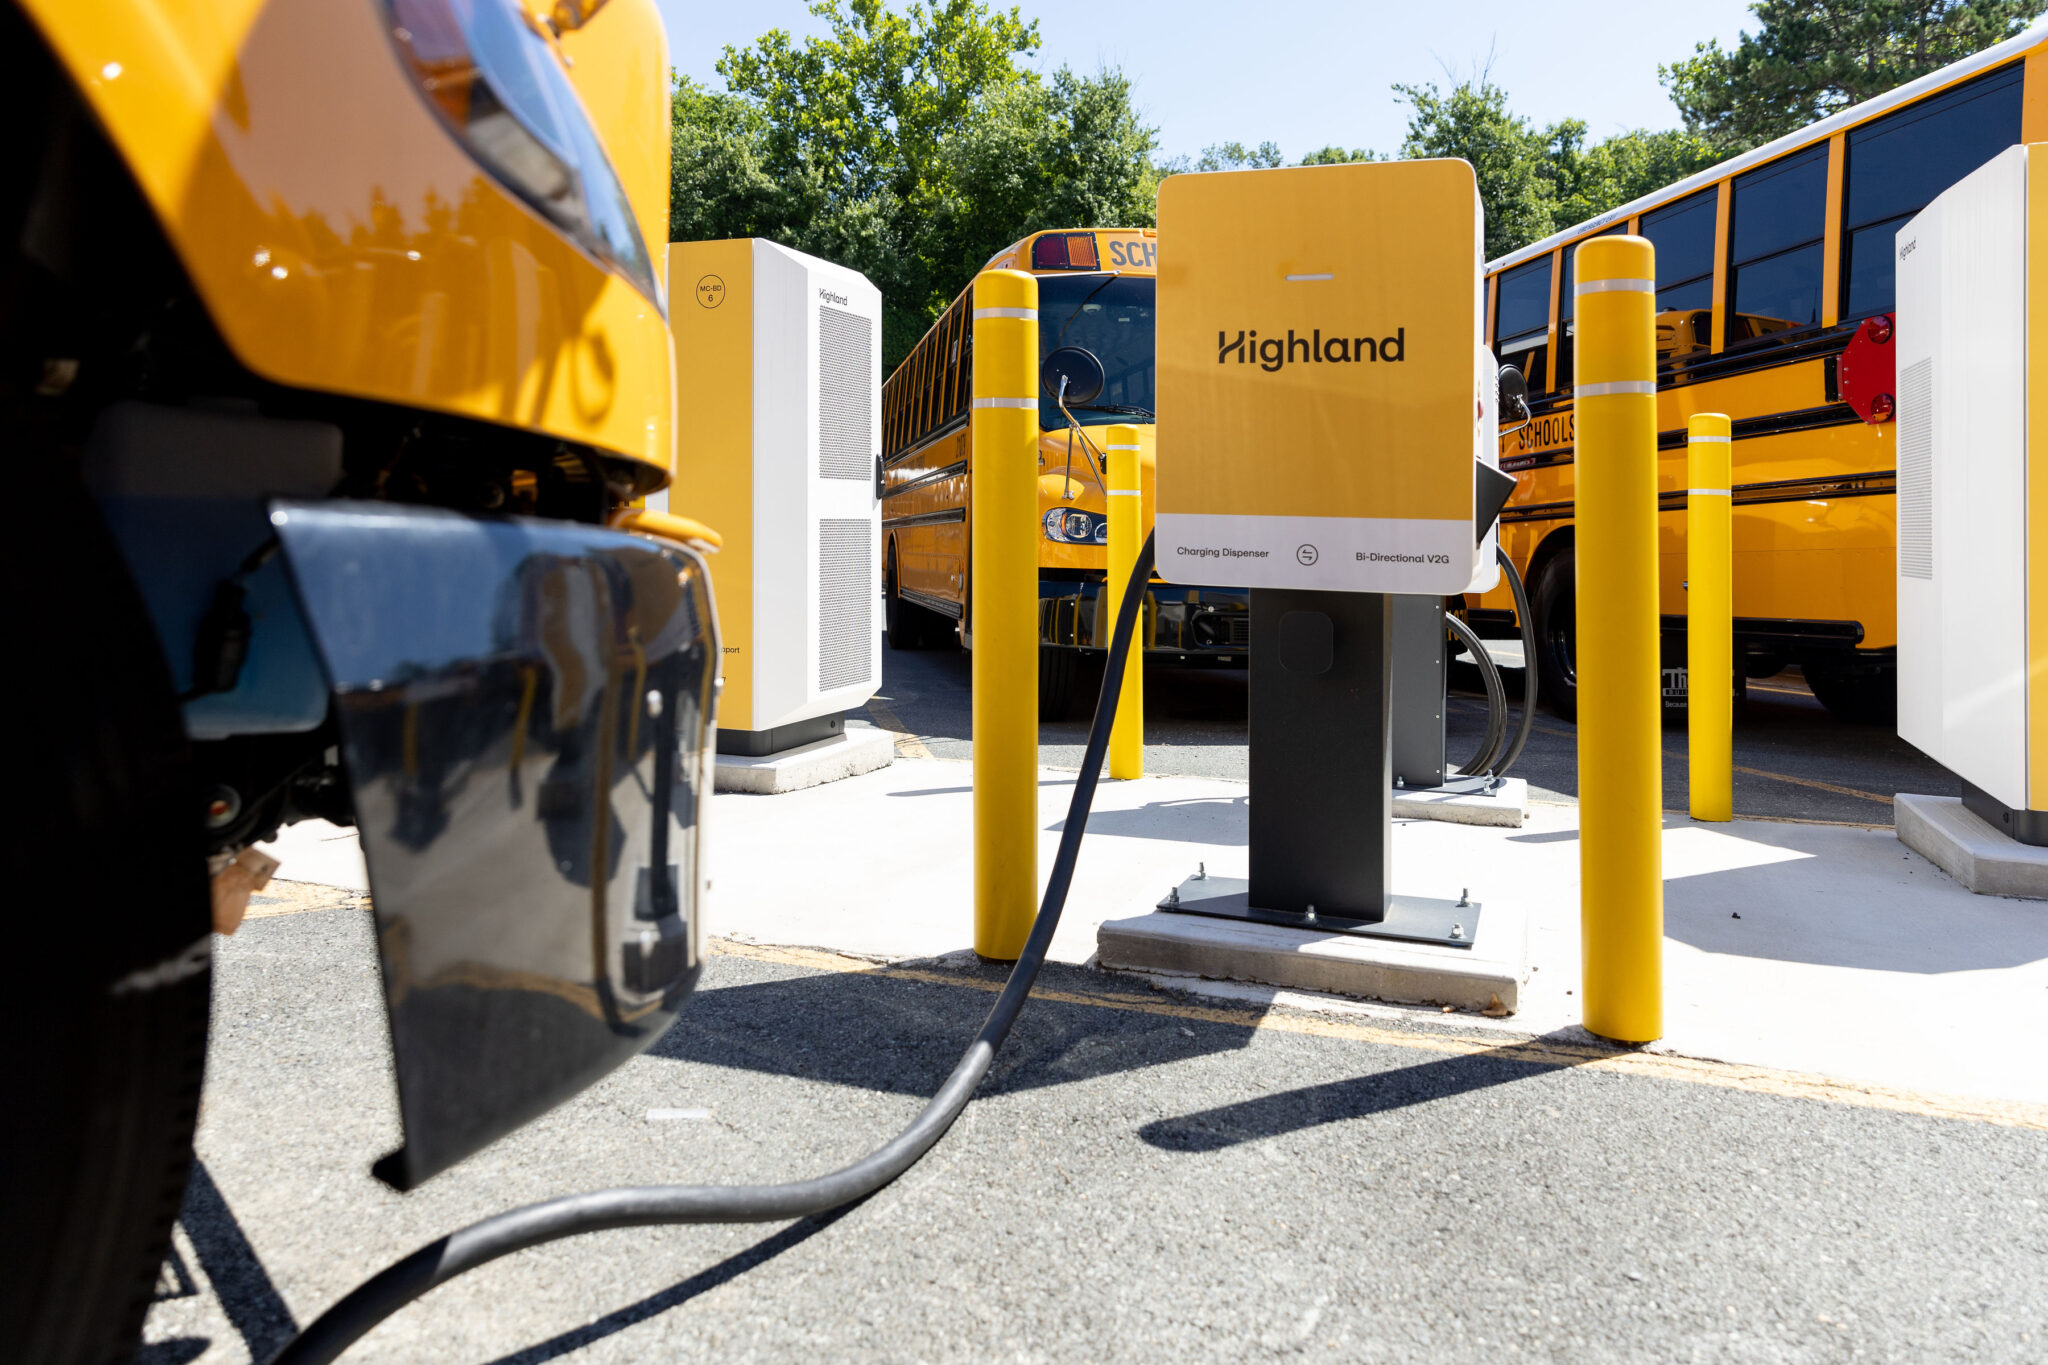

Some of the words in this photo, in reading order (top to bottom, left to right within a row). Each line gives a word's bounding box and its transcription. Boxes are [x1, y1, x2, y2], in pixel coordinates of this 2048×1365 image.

[708, 294, 714, 302] 6
[818, 287, 848, 306] Highland
[1218, 327, 1405, 373] Highland
[1518, 413, 1574, 450] SCHOOLS
[1176, 546, 1220, 558] Charging
[1222, 547, 1270, 559] Dispenser
[1355, 552, 1425, 564] Bi-Directional
[1427, 553, 1450, 565] V2G
